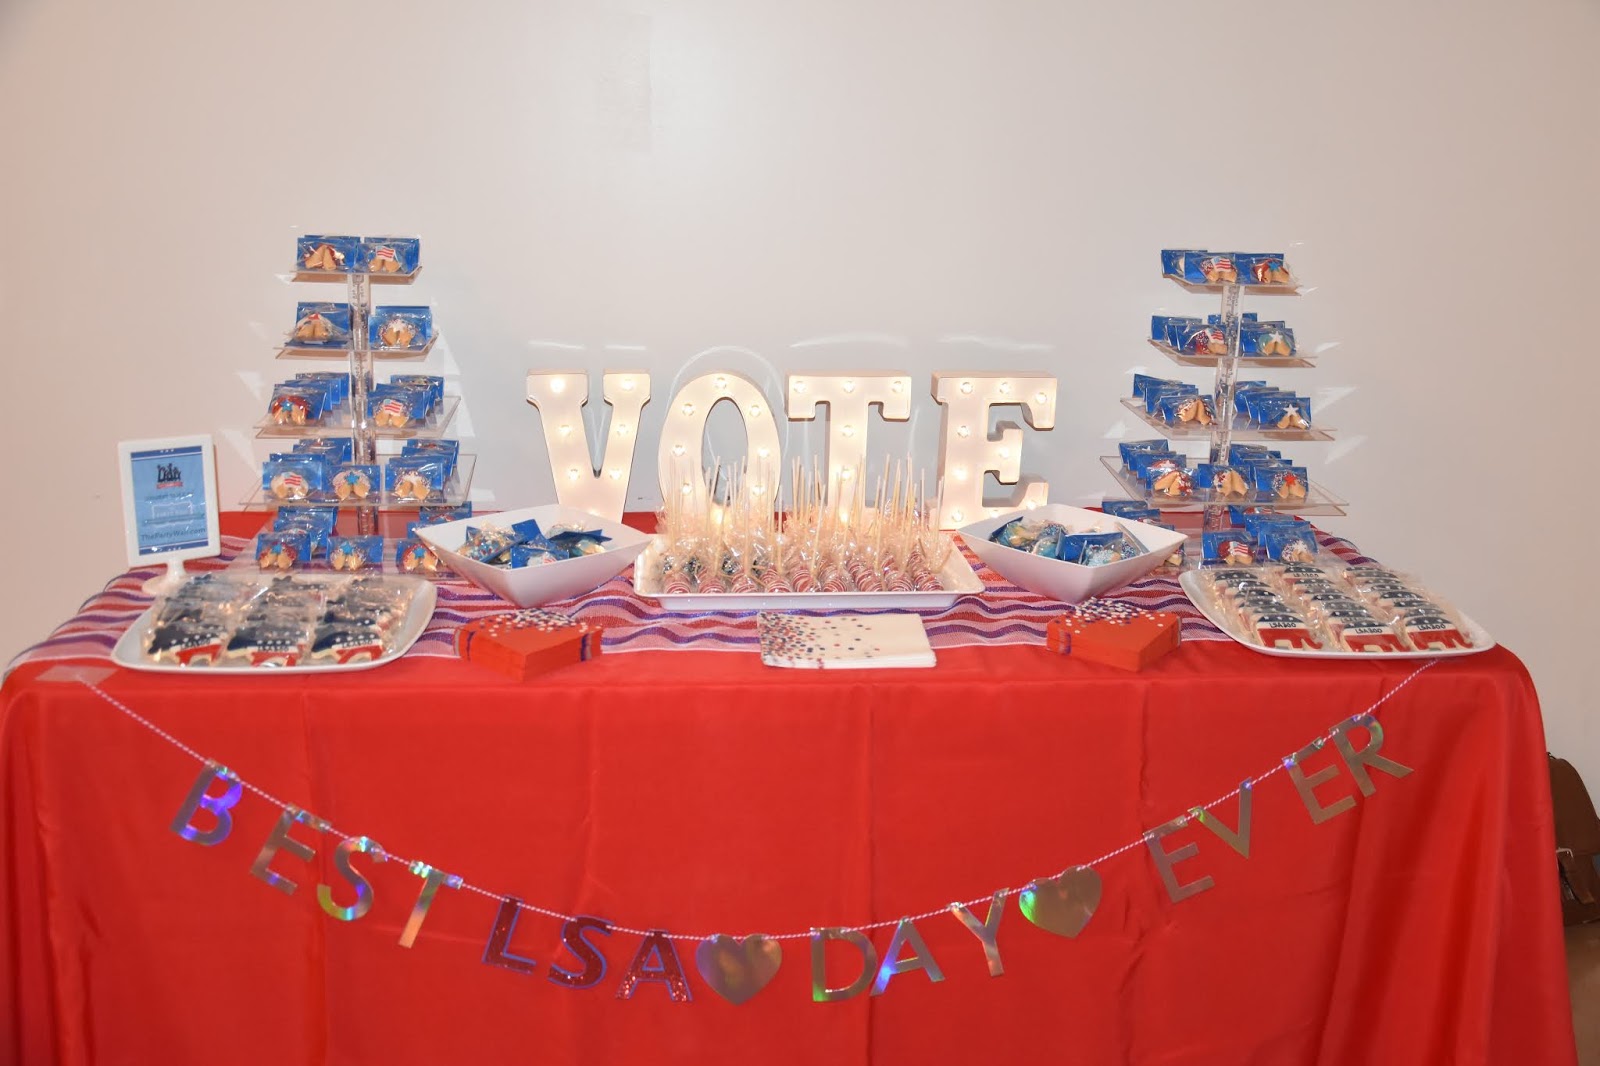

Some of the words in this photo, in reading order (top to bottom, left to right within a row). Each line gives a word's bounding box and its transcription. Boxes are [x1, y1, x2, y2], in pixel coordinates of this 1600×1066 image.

[526, 368, 1058, 530] VOTE
[170, 758, 463, 948] BEST
[481, 895, 693, 1002] LSA
[810, 887, 1009, 1001] DAY
[1144, 713, 1414, 903] EVER
